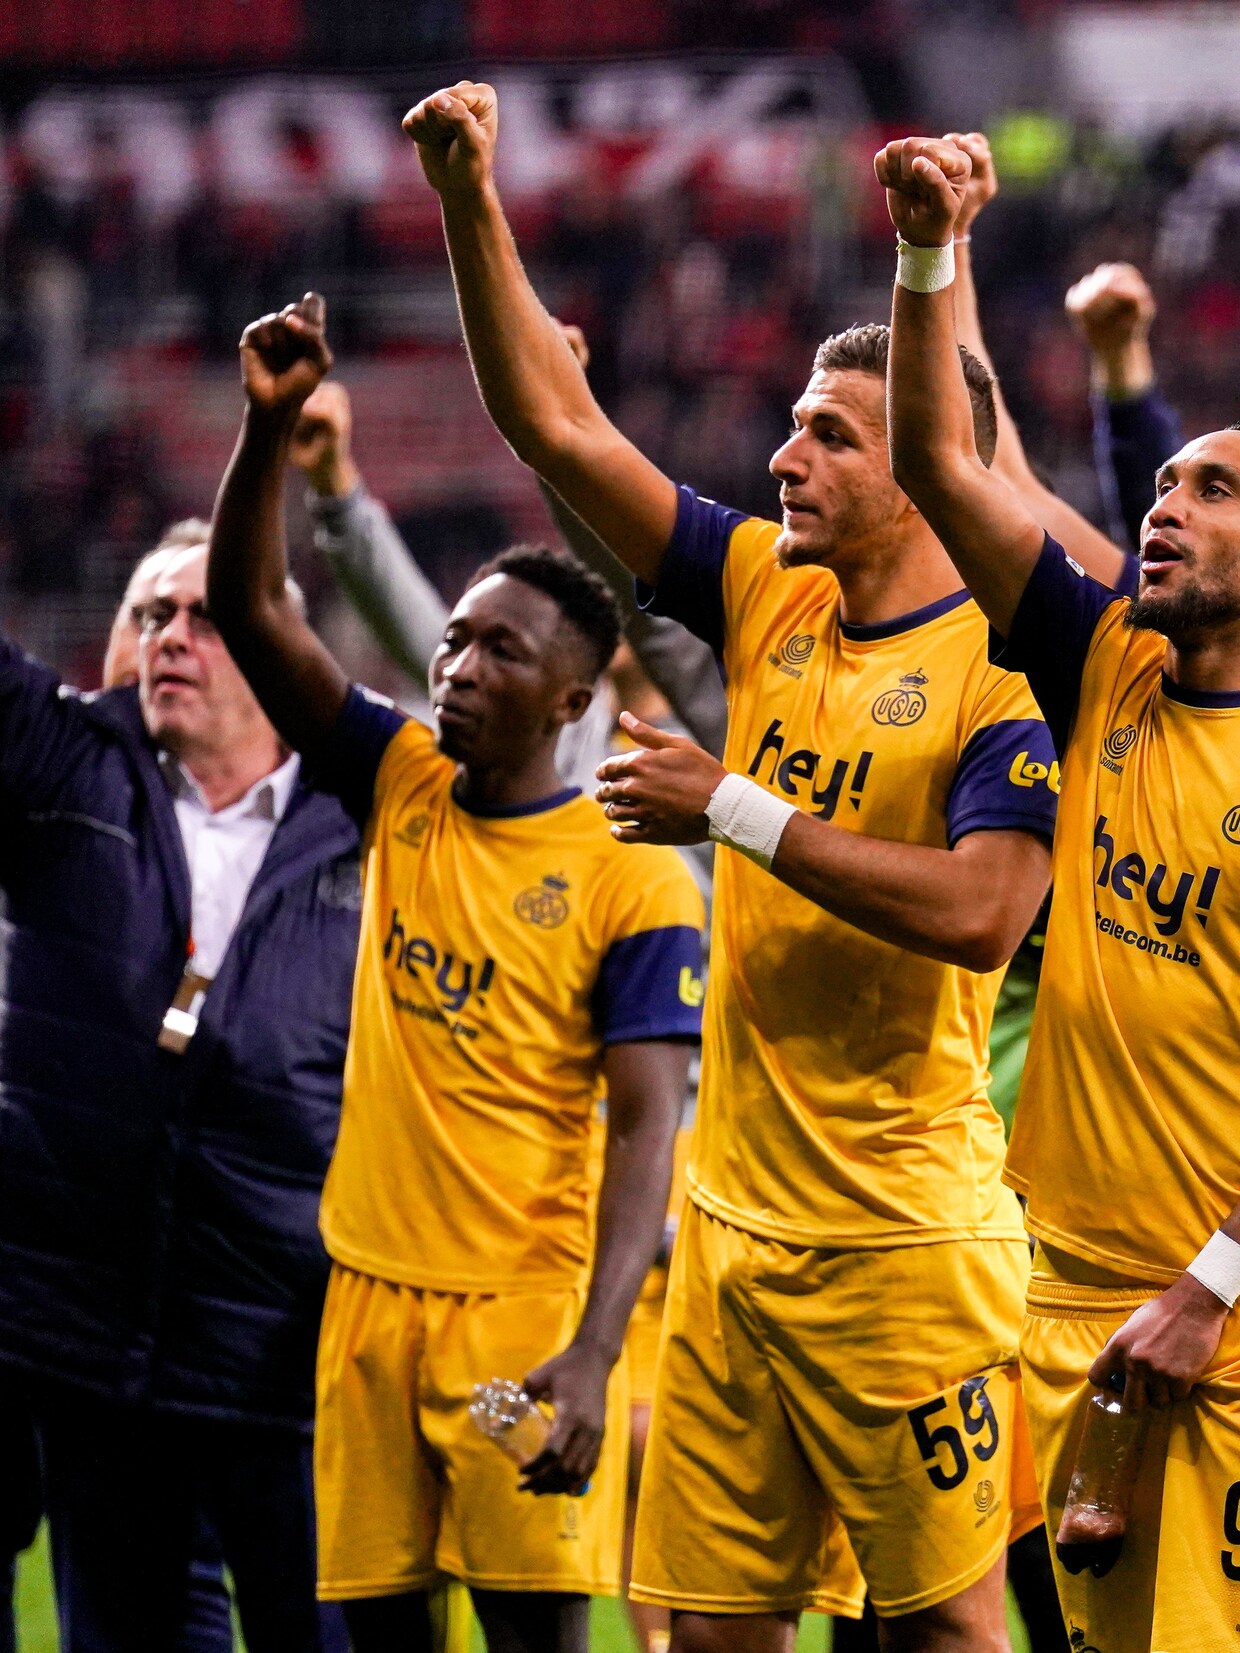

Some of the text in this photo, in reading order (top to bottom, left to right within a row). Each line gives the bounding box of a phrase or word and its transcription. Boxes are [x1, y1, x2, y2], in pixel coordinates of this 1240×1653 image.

[748, 719, 873, 821] hey!
[1009, 751, 1061, 795] Lot
[1094, 814, 1221, 936] hey!
[384, 908, 495, 1011] hey!
[1095, 911, 1200, 967] telecom.be
[907, 1376, 1000, 1490] 59
